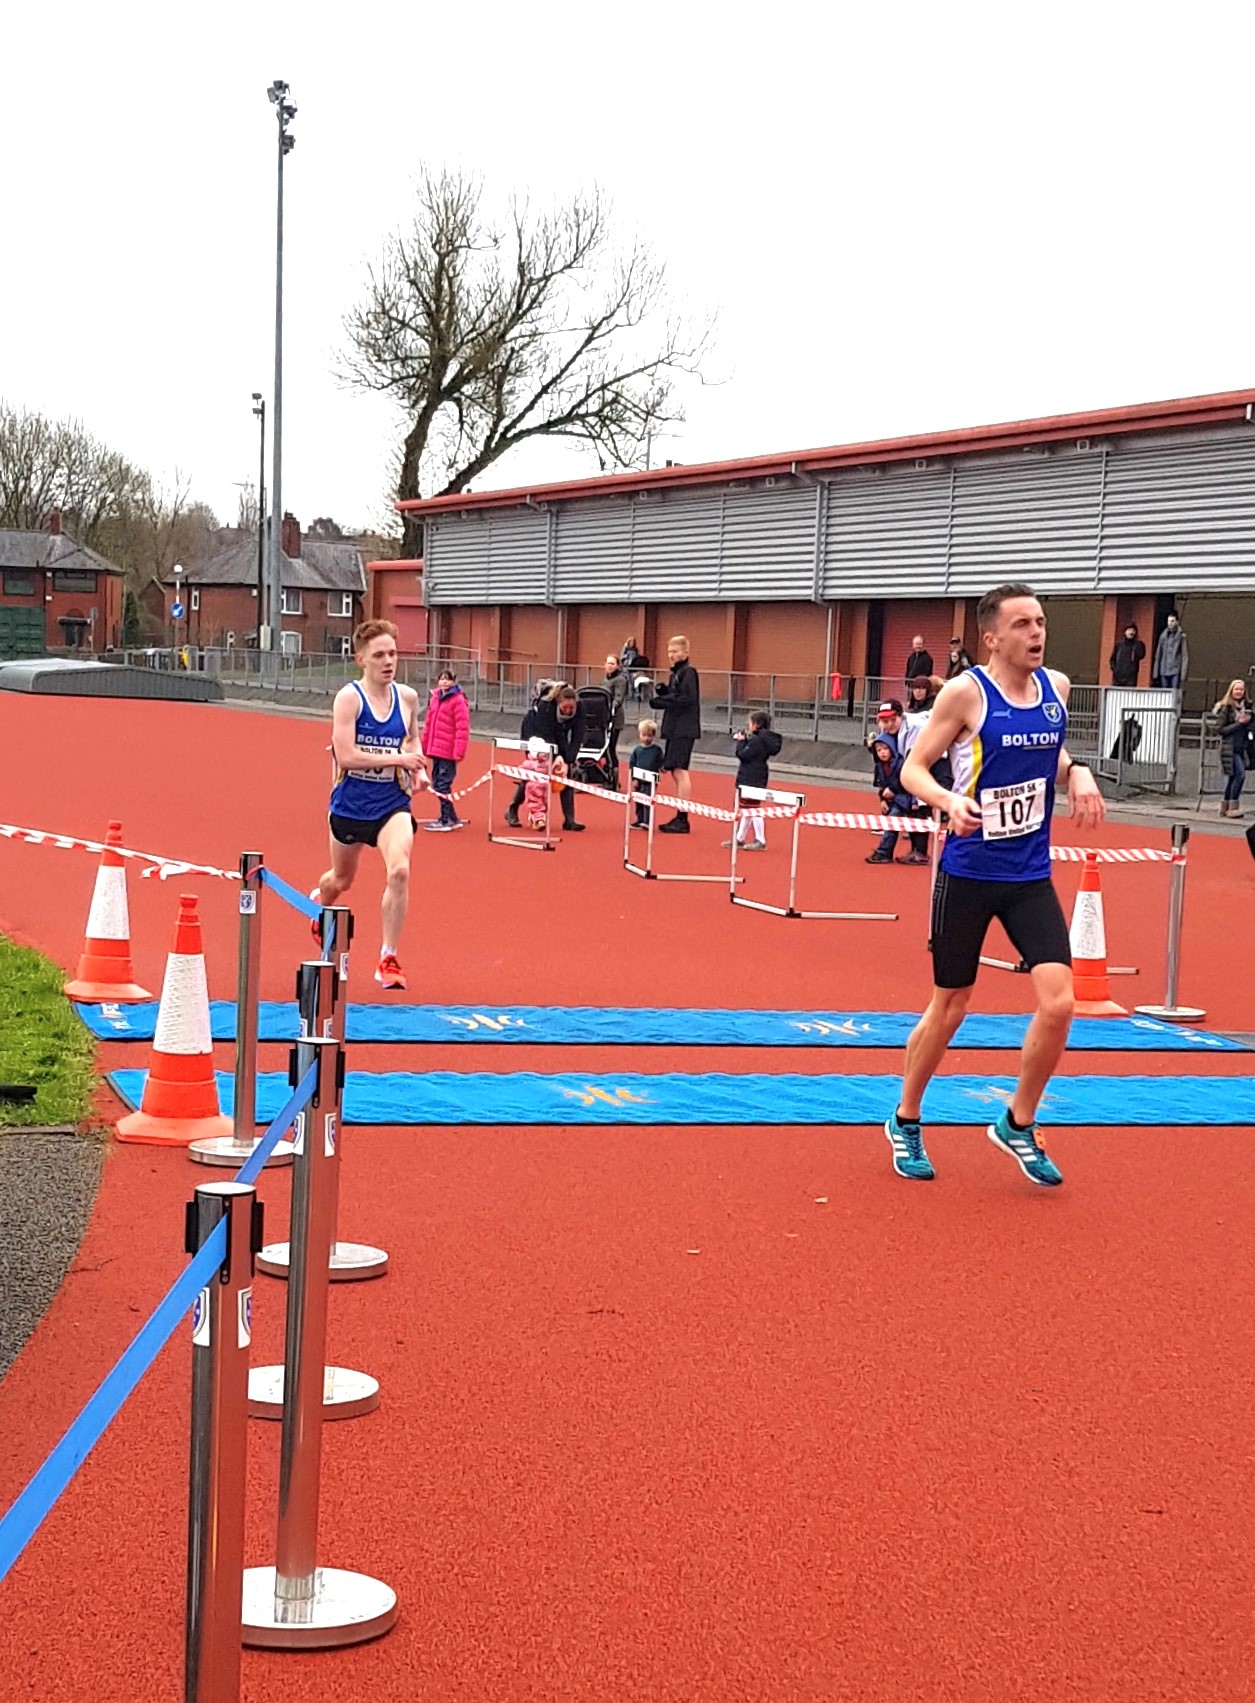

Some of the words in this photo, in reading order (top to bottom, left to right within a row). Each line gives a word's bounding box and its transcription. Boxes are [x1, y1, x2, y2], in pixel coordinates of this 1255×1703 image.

[356, 734, 401, 747] BOLTON
[1002, 732, 1059, 747] BOLTON
[993, 785, 1025, 800] BOLTON
[999, 794, 1036, 828] 107
